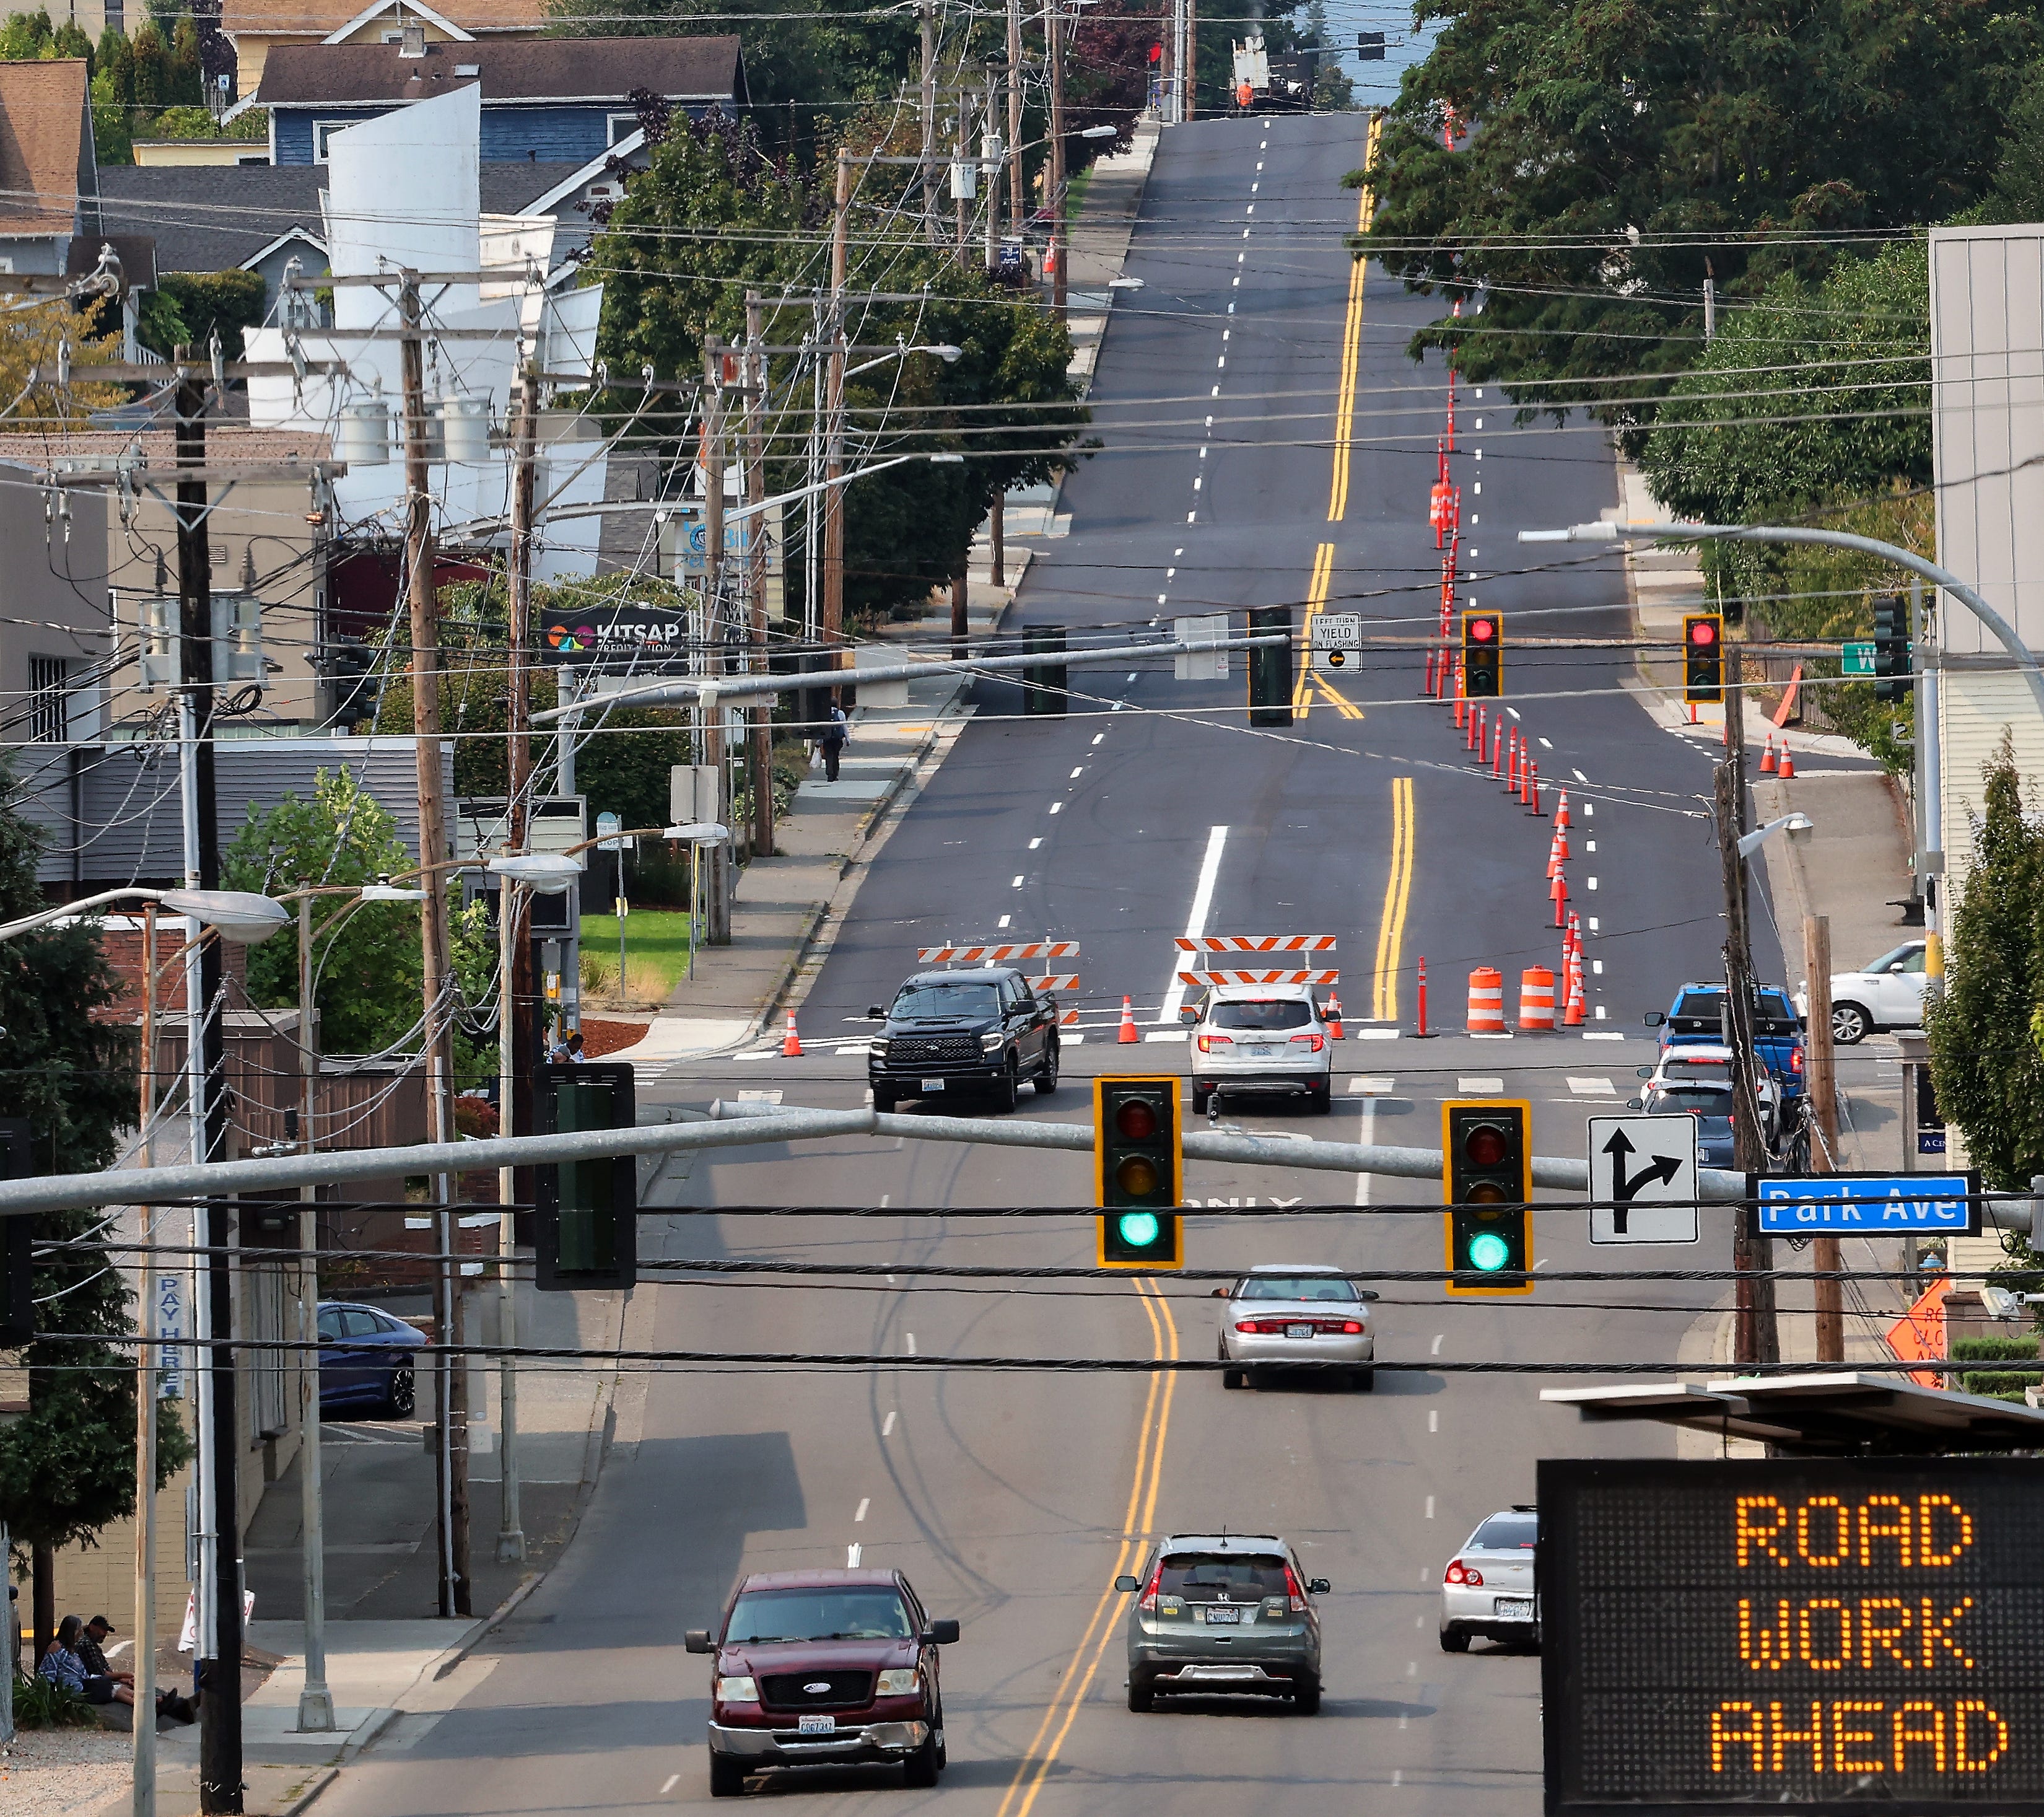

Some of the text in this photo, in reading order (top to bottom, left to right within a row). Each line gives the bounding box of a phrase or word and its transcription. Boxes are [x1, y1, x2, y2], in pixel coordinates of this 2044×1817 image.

[597, 623, 679, 645] KITSAP
[1321, 628, 1351, 639] YIELD
[1336, 618, 1355, 626] TURN
[1326, 640, 1358, 649] FLASHING
[1769, 1186, 1958, 1223] Park Ave
[160, 1279, 180, 1321] PAY
[1736, 1494, 1974, 1569] ROAD
[1737, 1596, 1975, 1671] WORK
[1710, 1699, 2011, 1774] AHEAD
